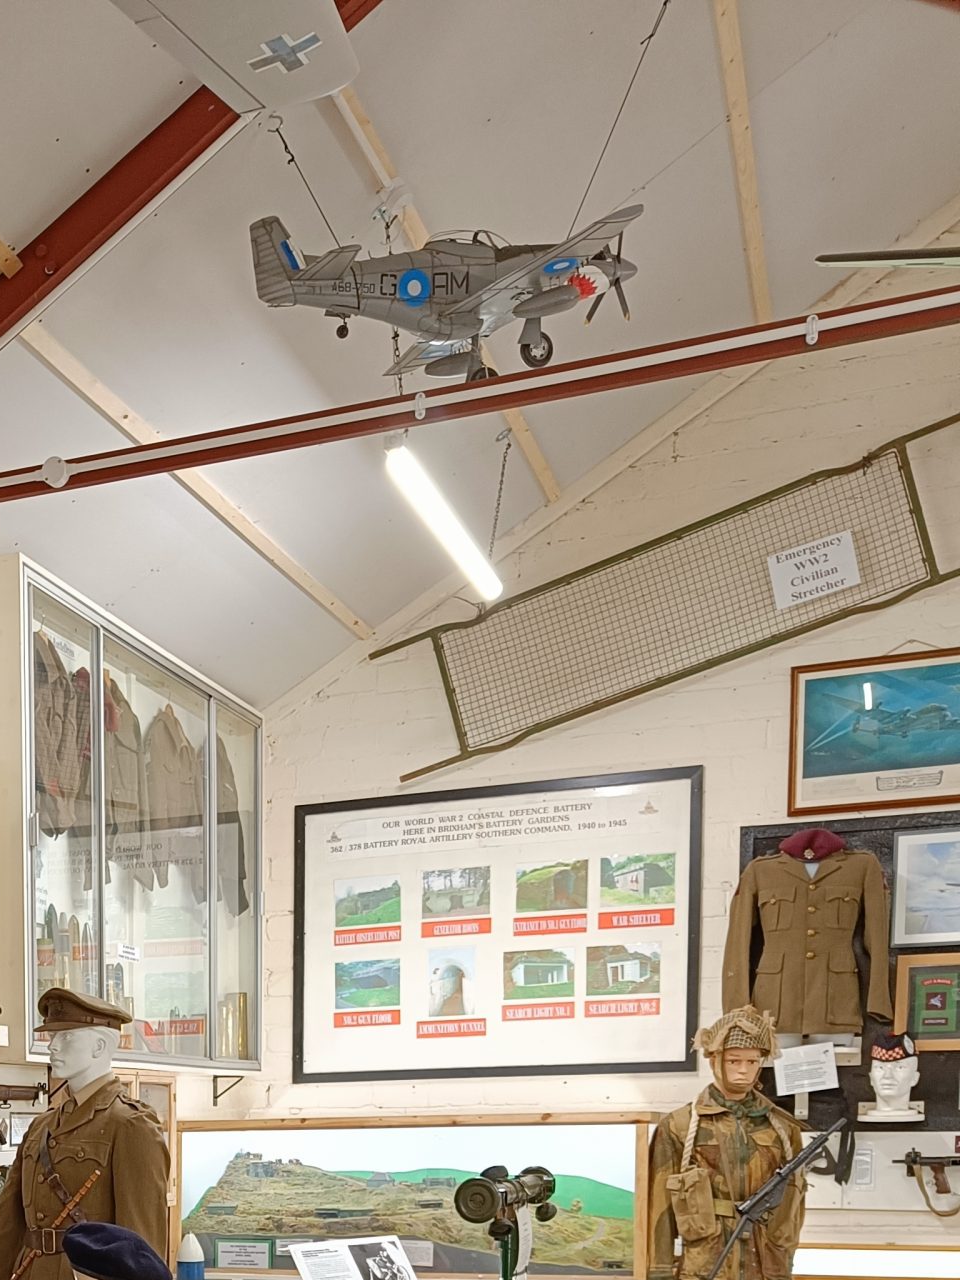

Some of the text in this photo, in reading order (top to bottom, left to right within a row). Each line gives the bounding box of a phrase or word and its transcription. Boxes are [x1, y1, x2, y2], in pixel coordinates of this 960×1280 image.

[380, 271, 469, 296] G AM
[775, 535, 844, 564] Emergency
[794, 553, 830, 572] WW2
[790, 565, 839, 587] Civilian
[791, 577, 847, 602] Stretcher
[382, 820, 401, 829] OUR
[404, 817, 435, 827] WORLD
[438, 814, 457, 824] WAR
[467, 810, 505, 821] COASTAL
[509, 807, 549, 818] DEFENCE
[553, 803, 593, 814] BATTERY
[402, 815, 570, 837] HERE IN BRIXHAM'S BATTERY GARDENS
[330, 845, 343, 854] 362
[349, 843, 362, 852] 378
[363, 839, 400, 850] BATTERY
[401, 836, 428, 846] ROYAL
[428, 832, 474, 844] ARTILLERY
[475, 829, 522, 840] SOUTHERN
[577, 821, 596, 831] 1940
[608, 819, 628, 829] 1945
[358, 1014, 371, 1025] GUN
[372, 1013, 392, 1024] FLOOR
[506, 1007, 533, 1018] SEARCH
[533, 1006, 553, 1018] LIGHT
[589, 1003, 615, 1015] SEARCH
[616, 1002, 639, 1013] LIGHT
